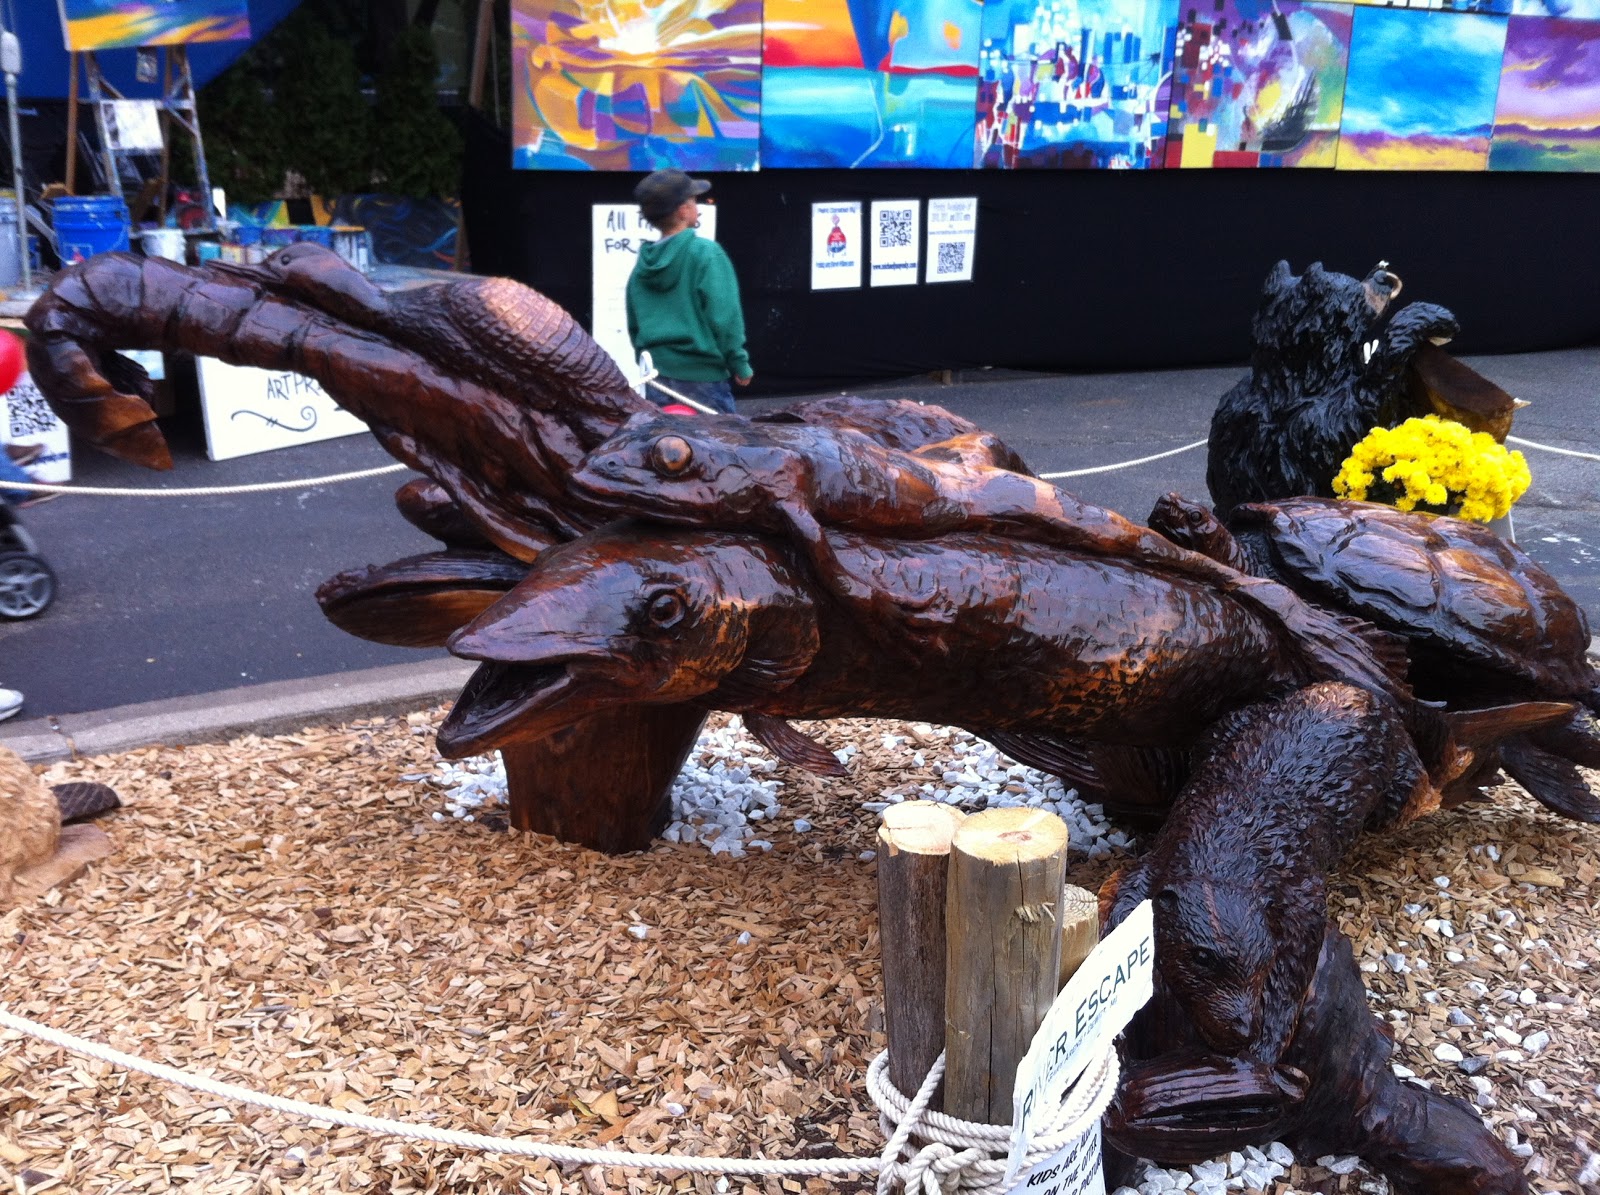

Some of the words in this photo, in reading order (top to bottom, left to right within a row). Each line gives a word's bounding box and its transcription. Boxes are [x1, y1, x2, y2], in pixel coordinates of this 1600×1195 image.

[605, 238, 637, 254] FOR
[1021, 1030, 1068, 1134] RIVER
[1075, 936, 1151, 1039] ESCAPE
[1026, 1164, 1060, 1188] KIDS
[1061, 1142, 1079, 1173] ARE
[1063, 1163, 1080, 1191] THE
[1081, 1134, 1098, 1171] OTTER
